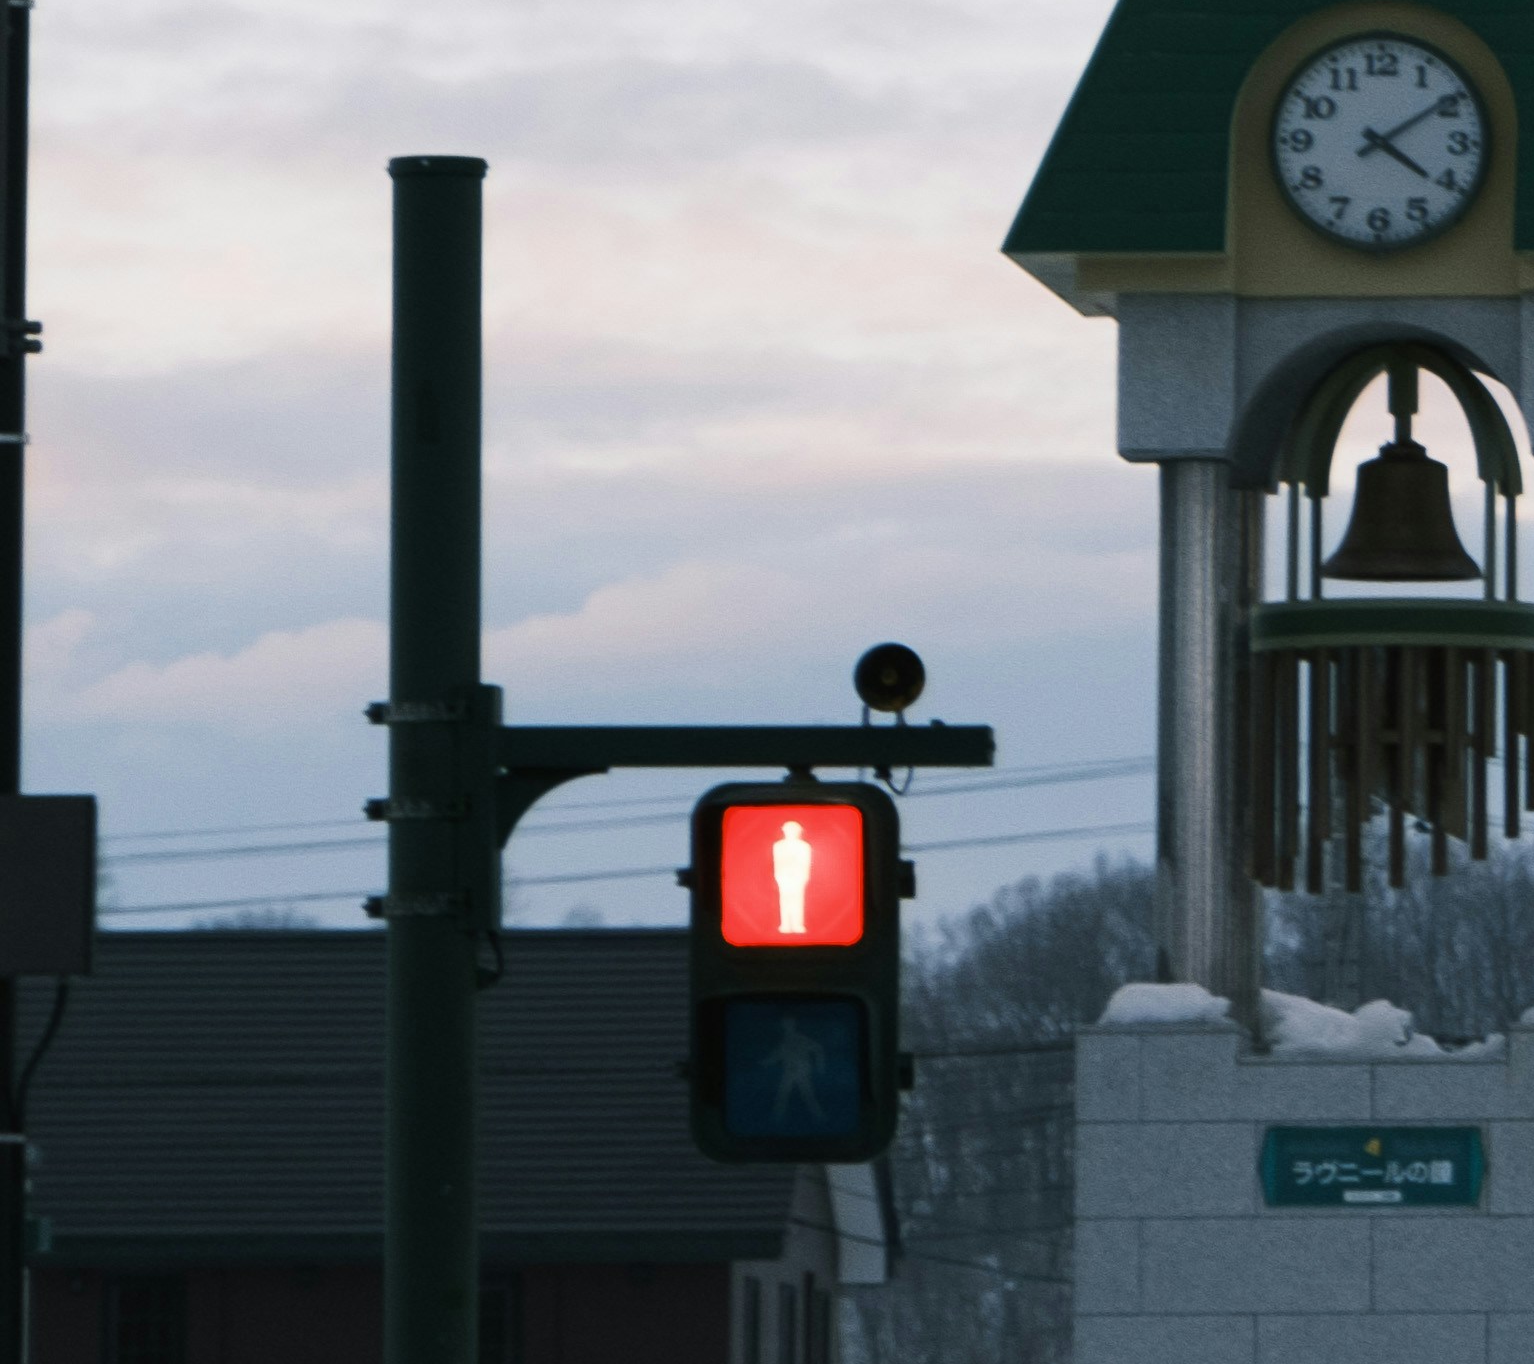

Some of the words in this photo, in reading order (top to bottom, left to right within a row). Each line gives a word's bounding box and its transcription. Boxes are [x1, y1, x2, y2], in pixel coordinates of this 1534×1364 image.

[1365, 53, 1399, 76] 12
[1330, 68, 1358, 91] 11
[1416, 65, 1429, 88] 1
[1303, 96, 1336, 119] 10
[1437, 94, 1460, 117] 2
[1289, 128, 1314, 153] 9
[1446, 131, 1470, 156] 3
[1301, 165, 1323, 190] 8
[1435, 168, 1457, 191] 4
[1329, 196, 1351, 219] 7
[1406, 197, 1428, 221] 5
[1366, 207, 1390, 232] 6
